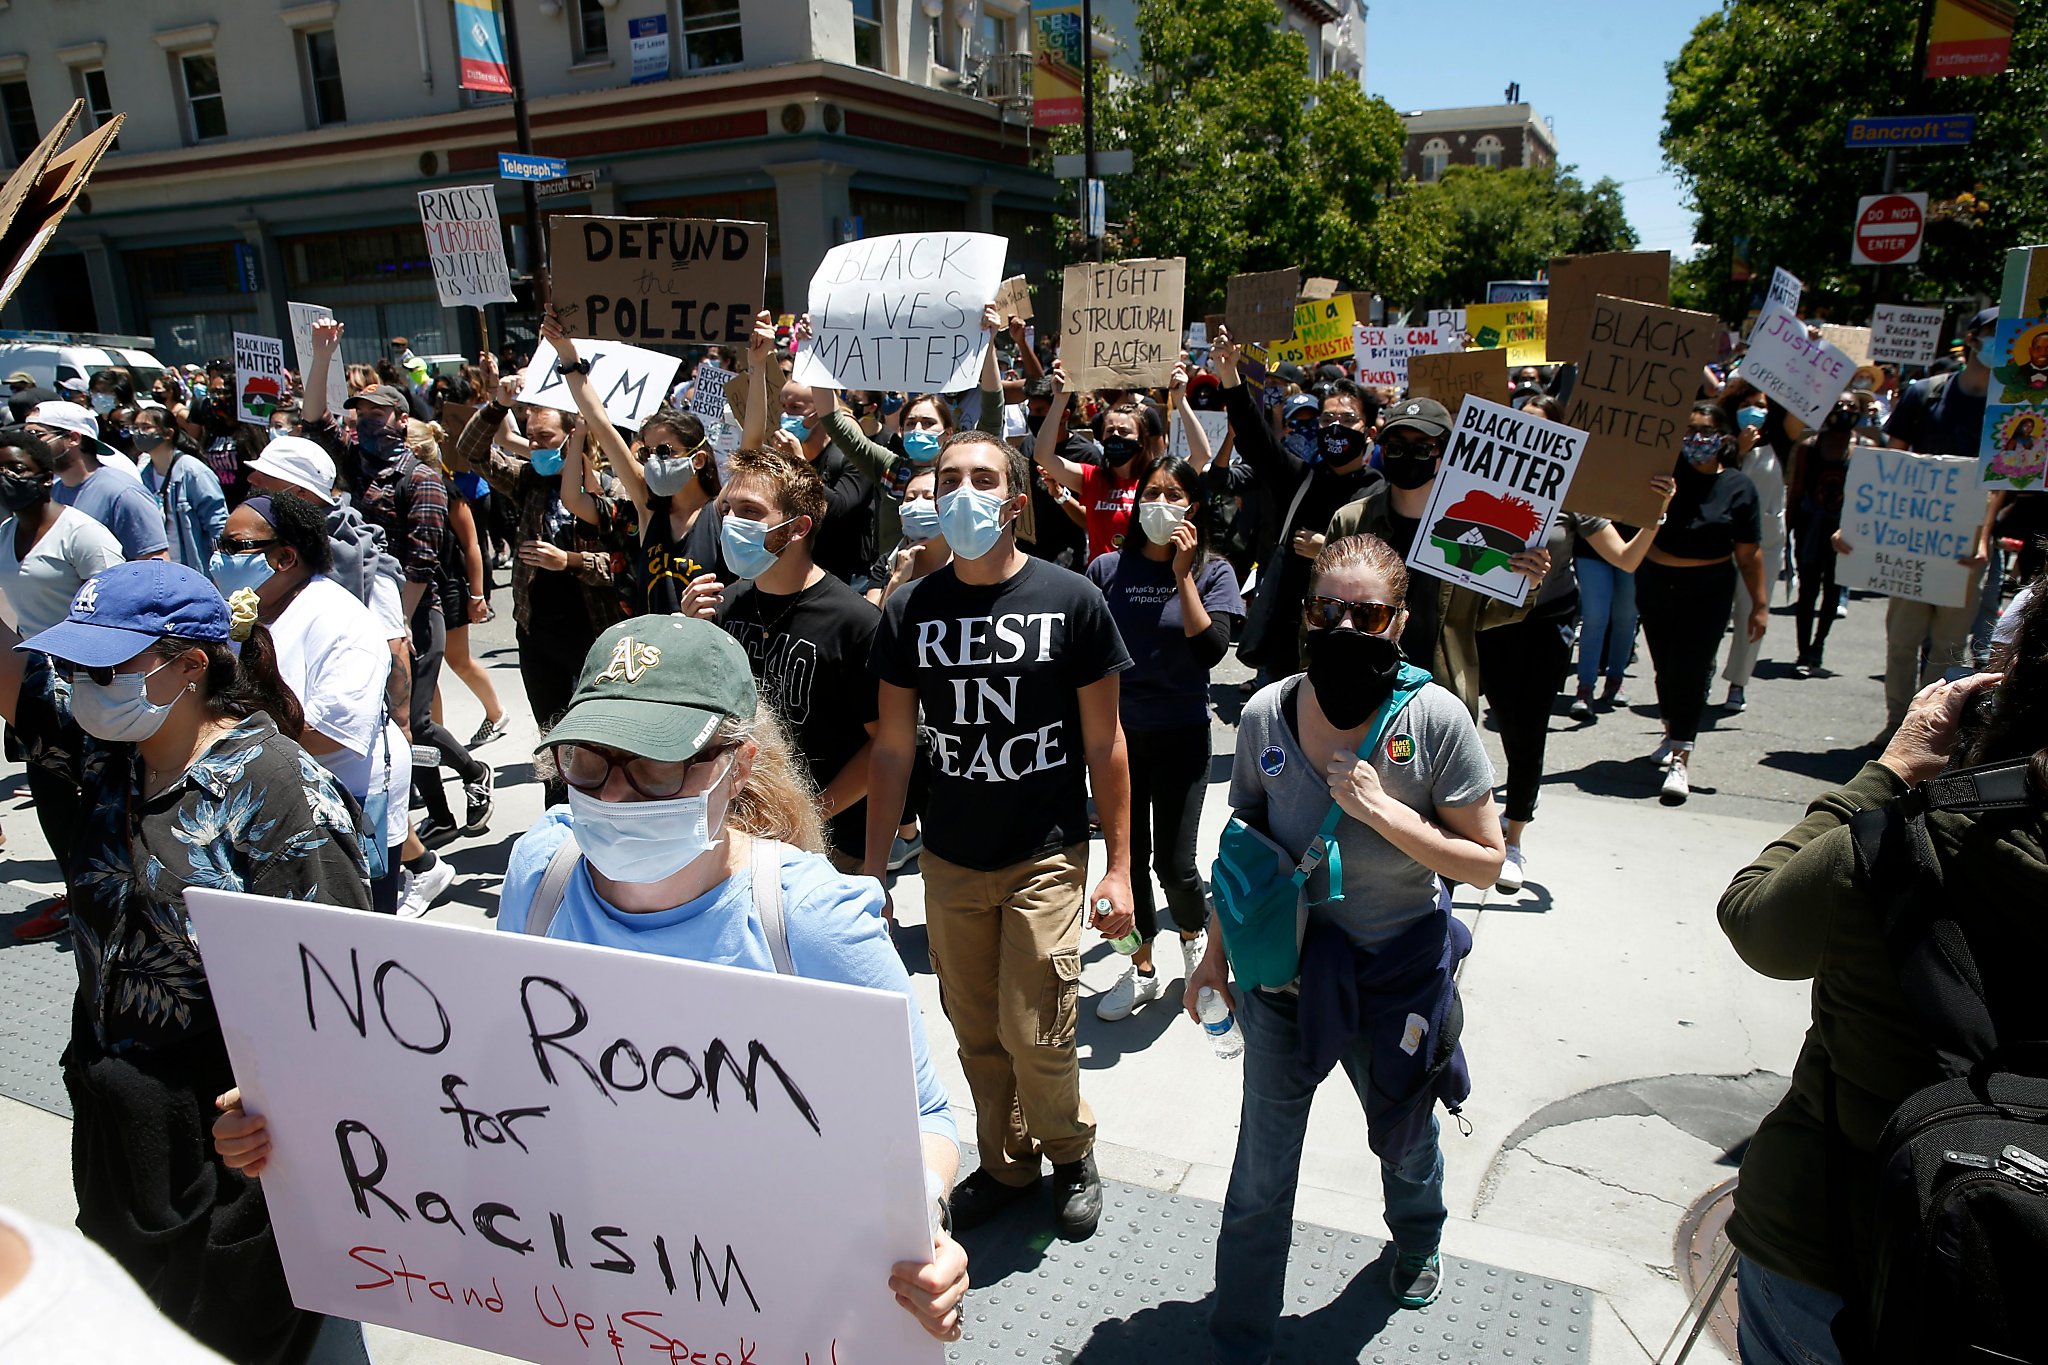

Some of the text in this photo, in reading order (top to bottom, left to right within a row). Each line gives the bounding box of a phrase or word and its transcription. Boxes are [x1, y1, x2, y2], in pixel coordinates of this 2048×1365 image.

[1852, 122, 1939, 141] Bancroft
[502, 158, 551, 178] Telegraph
[535, 177, 570, 196] Bancroft
[421, 187, 489, 220] RACIST
[1867, 207, 1915, 221] DO NOT
[424, 219, 501, 255] MURDERERS
[583, 221, 749, 261] DEFUND
[1868, 238, 1906, 250] ENTER
[827, 237, 976, 285] BLACK
[633, 269, 680, 295] the
[1095, 268, 1166, 299] FIGHT
[823, 290, 966, 331] LIVES
[1769, 283, 1798, 312] MATTER
[586, 295, 751, 342] POLICE
[1068, 305, 1175, 336] STRUCTURAL
[1302, 318, 1344, 345] MADRE
[1506, 311, 1534, 326] KNOW
[1591, 307, 1696, 358] BLACK
[1876, 311, 1942, 326] WE CREATED
[1885, 325, 1930, 338] RACISM
[236, 337, 258, 351] BLACK
[260, 340, 280, 356] LIVES
[1360, 330, 1387, 346] SEX
[1394, 333, 1404, 345] is
[1407, 329, 1438, 346] COOL
[1506, 325, 1534, 342] KNOW
[1768, 314, 1844, 379] JUSTICE
[1874, 336, 1888, 345] WE
[1921, 341, 1934, 350] TO
[237, 351, 281, 375] MATTER
[801, 332, 983, 384] MATTER!
[1094, 339, 1161, 369] RACISM
[1371, 347, 1387, 359] BUT
[701, 367, 732, 384] RESPECT
[1361, 369, 1396, 385] FUCKED
[1413, 358, 1453, 379] SAY
[1433, 371, 1488, 393] THEIR
[1581, 349, 1687, 408] LIVES
[1462, 405, 1577, 461] BLACK LIVES
[1566, 399, 1675, 449] MATTER
[1327, 444, 1342, 453] 2020
[1448, 431, 1565, 501] MATTER
[1876, 455, 1961, 495] WHITE
[1855, 483, 1956, 523] SILENCE
[1874, 520, 1971, 561] VIOLENCE
[648, 553, 702, 577] CITY
[1875, 552, 1926, 573] BLACK
[1880, 565, 1922, 583] LIVES
[75, 579, 99, 612] LA
[1125, 584, 1153, 594] what's
[1129, 594, 1169, 604] impact?
[1868, 577, 1923, 597] MATTER
[916, 612, 1066, 668] REST
[594, 636, 662, 686] A's
[948, 676, 1022, 725] IN
[924, 720, 1067, 782] PEACE
[299, 942, 451, 1055] NO
[440, 1074, 550, 1154] for
[348, 1244, 505, 1313] Stand
[534, 1284, 596, 1348] Up
